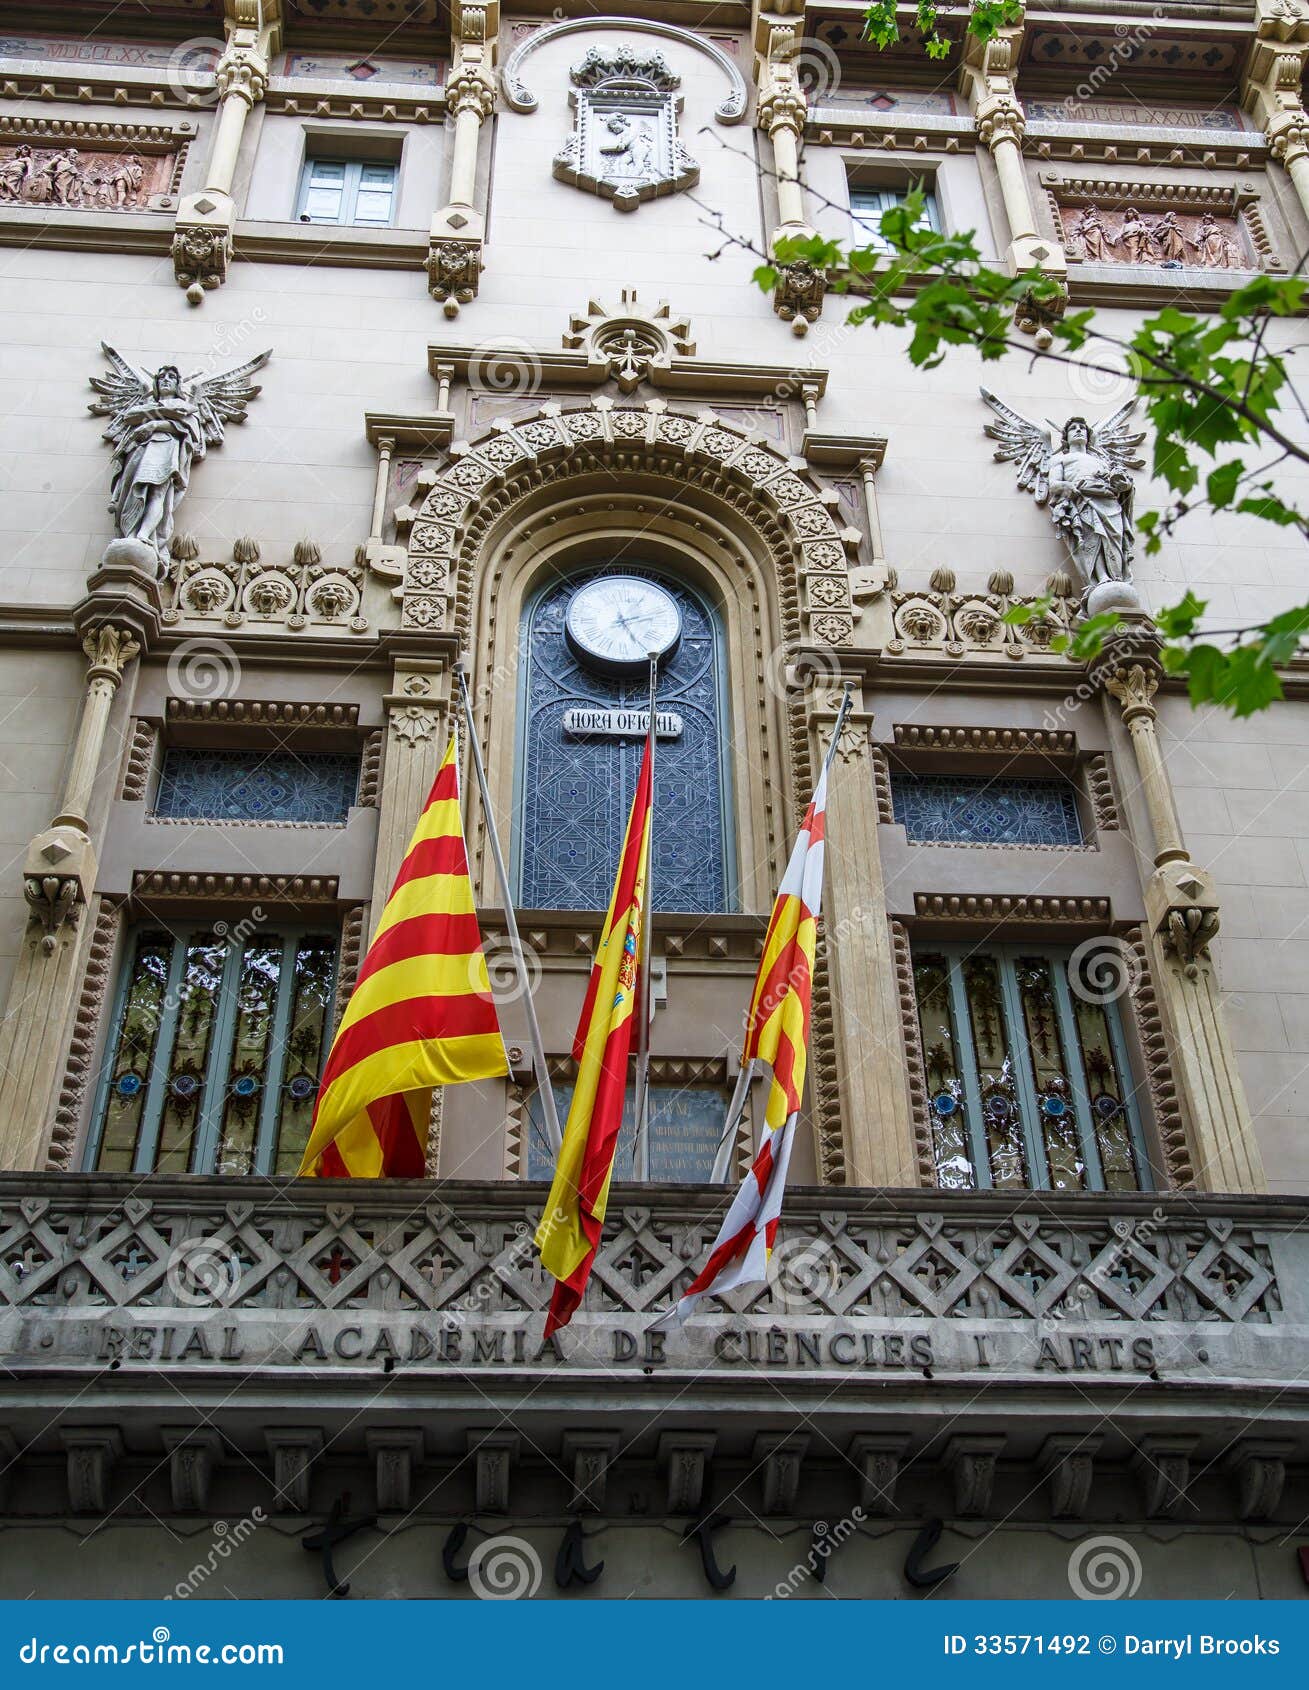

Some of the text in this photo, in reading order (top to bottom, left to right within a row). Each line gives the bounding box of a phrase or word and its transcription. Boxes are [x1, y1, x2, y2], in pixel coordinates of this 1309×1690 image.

[569, 711, 678, 732] HORA OFICAL
[97, 1326, 245, 1360] REIAL
[612, 1328, 667, 1363] DE
[714, 1324, 936, 1368] CIÈNCIES
[973, 1334, 991, 1368] I
[1033, 1336, 1156, 1370] ARTS
